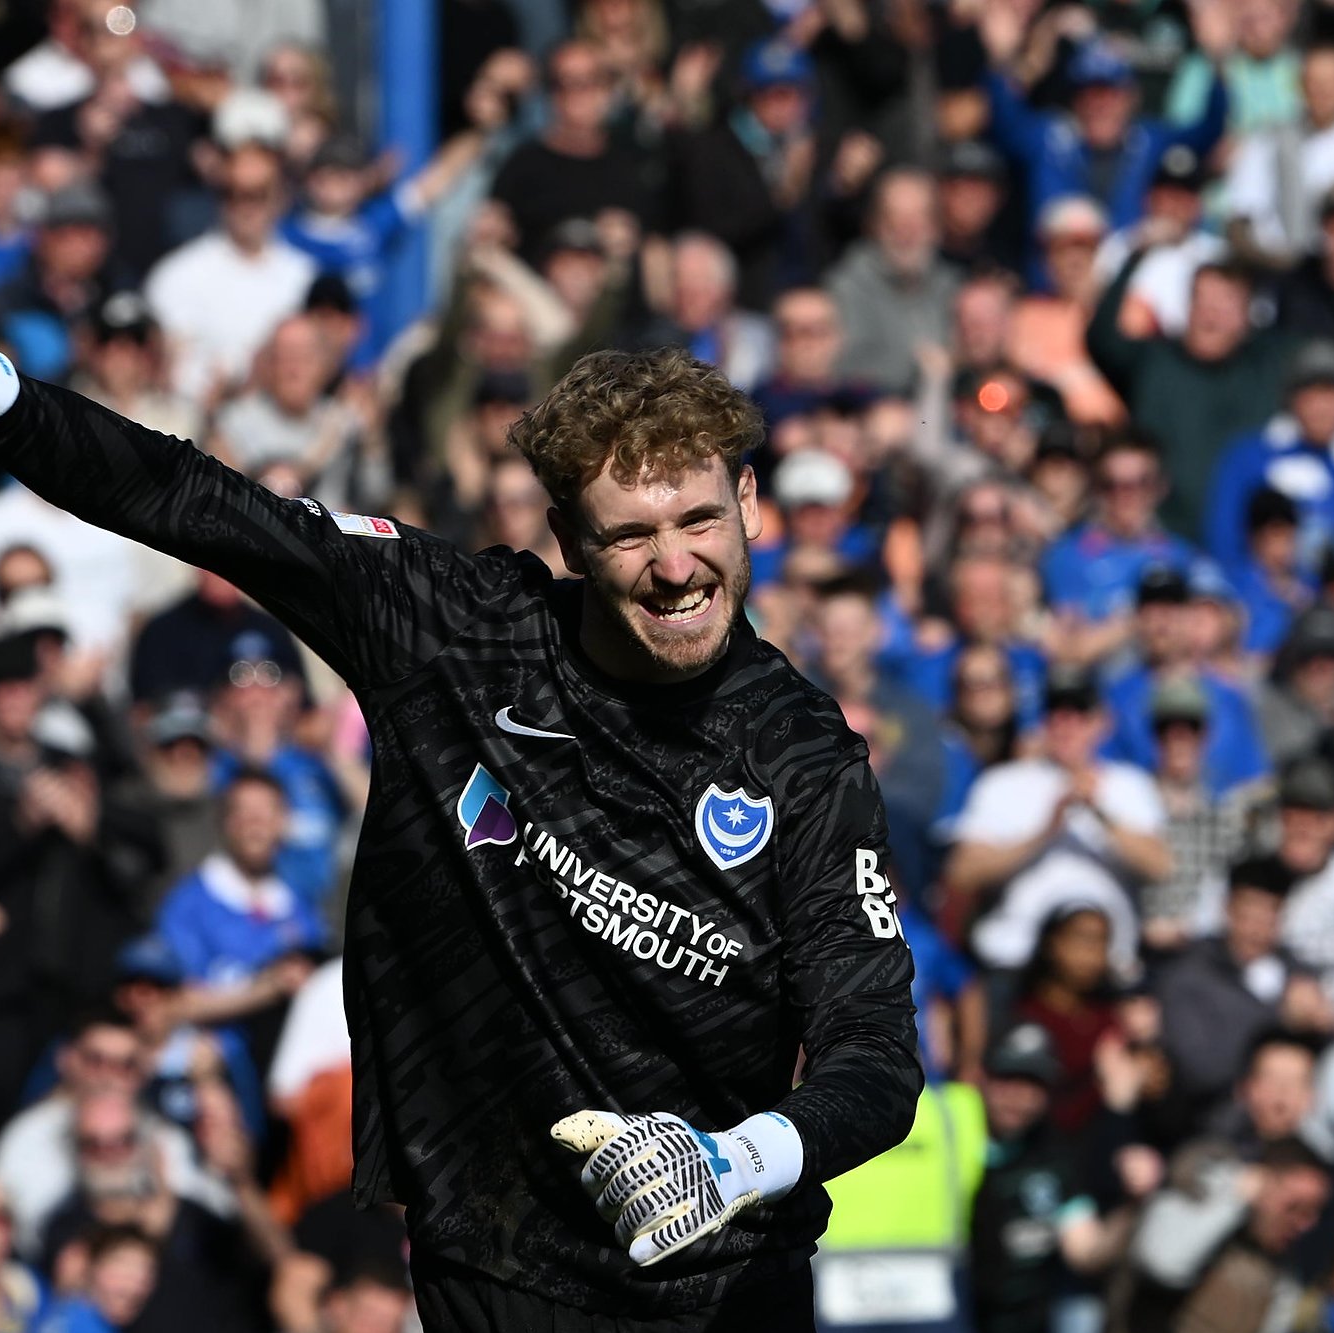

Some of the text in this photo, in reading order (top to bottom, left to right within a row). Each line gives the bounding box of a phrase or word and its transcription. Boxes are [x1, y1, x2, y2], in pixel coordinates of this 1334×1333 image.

[523, 821, 744, 960] UNIVERSITY OF
[736, 1135, 765, 1174] Schmid
